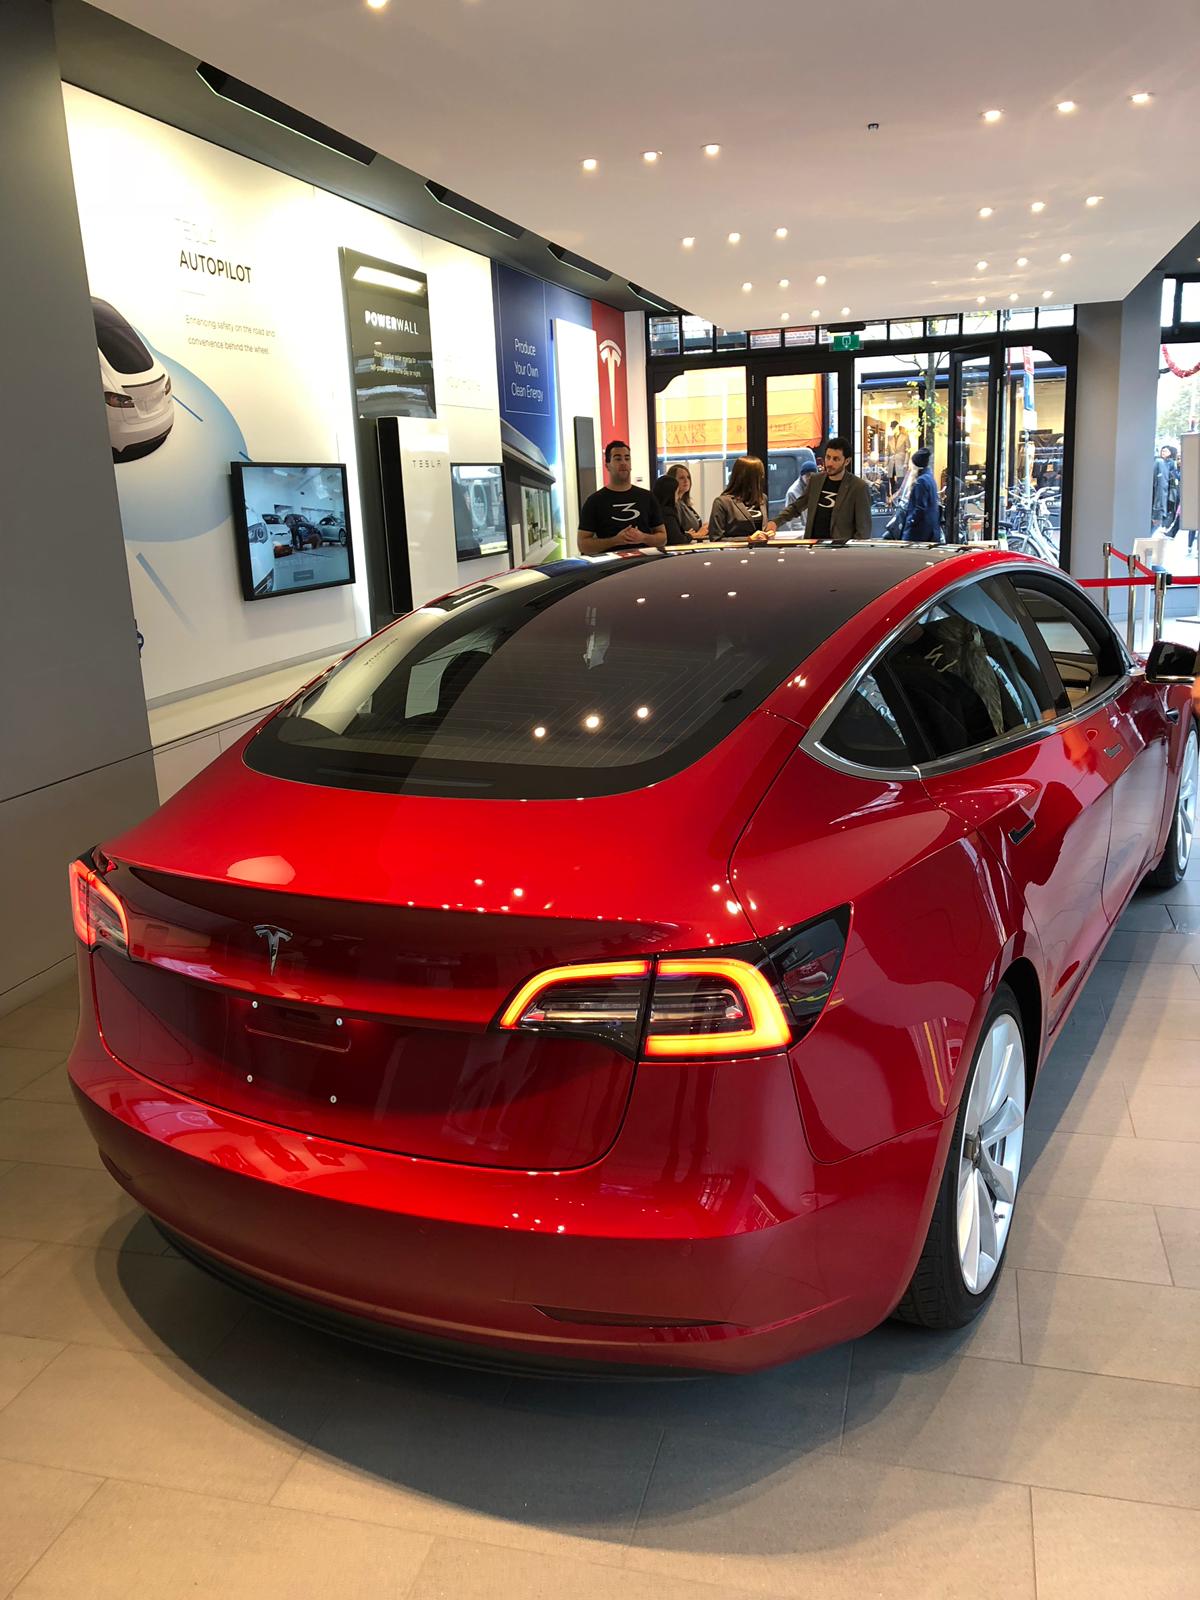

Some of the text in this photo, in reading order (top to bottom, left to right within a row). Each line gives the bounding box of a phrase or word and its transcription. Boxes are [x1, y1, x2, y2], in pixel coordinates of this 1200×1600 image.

[179, 249, 252, 284] AUTOPILOT
[185, 314, 217, 330] Enhancing
[234, 324, 243, 333] on
[243, 325, 252, 335] the
[364, 310, 420, 336] POWERWALL
[187, 336, 224, 350] convenience
[224, 341, 244, 352] behind
[244, 344, 254, 353] the
[514, 338, 536, 357] Produce
[513, 360, 539, 378] Your Own
[511, 382, 544, 402] Clean Energy
[412, 459, 441, 468] TESLA
[818, 490, 838, 508] 3
[611, 502, 641, 522] 3
